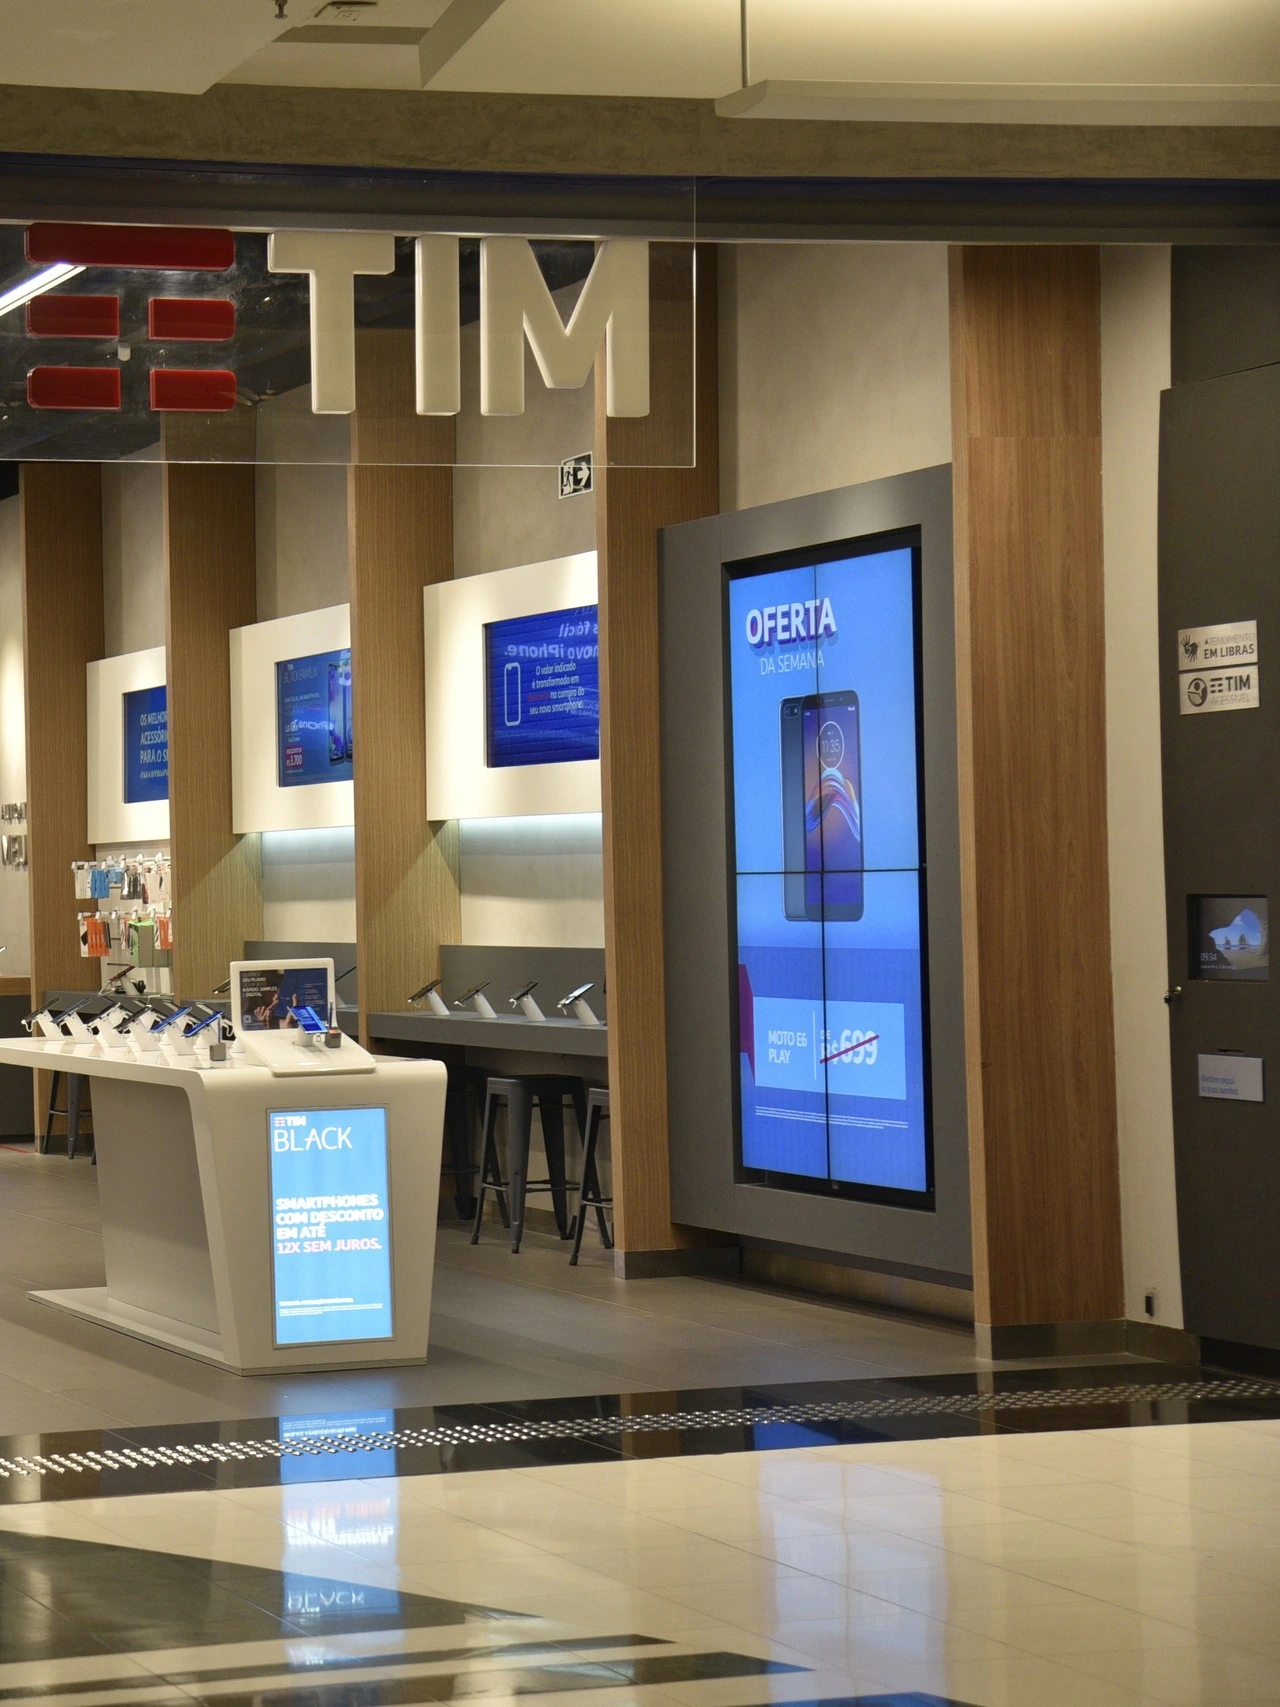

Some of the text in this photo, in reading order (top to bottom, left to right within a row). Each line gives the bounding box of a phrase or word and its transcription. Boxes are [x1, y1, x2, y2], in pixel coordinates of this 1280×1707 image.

[267, 230, 650, 418] TIM
[746, 597, 838, 646] OFERTA
[1204, 633, 1255, 646] ATENDIMENTO
[1204, 644, 1255, 660] EM LIBRAS
[760, 650, 825, 675] DA SEMANA
[1225, 674, 1251, 692] TIM
[768, 1030, 808, 1048] MOTO E6
[769, 1048, 791, 1064] PLAY
[286, 1115, 306, 1127] TIM
[274, 1127, 353, 1152] BLACK
[275, 1194, 379, 1211] SMARTPHONES
[276, 1208, 384, 1225] COM DESCONTO
[276, 1221, 326, 1240] EM ATÉ
[277, 1238, 382, 1254] 12X SEM JUROS.
